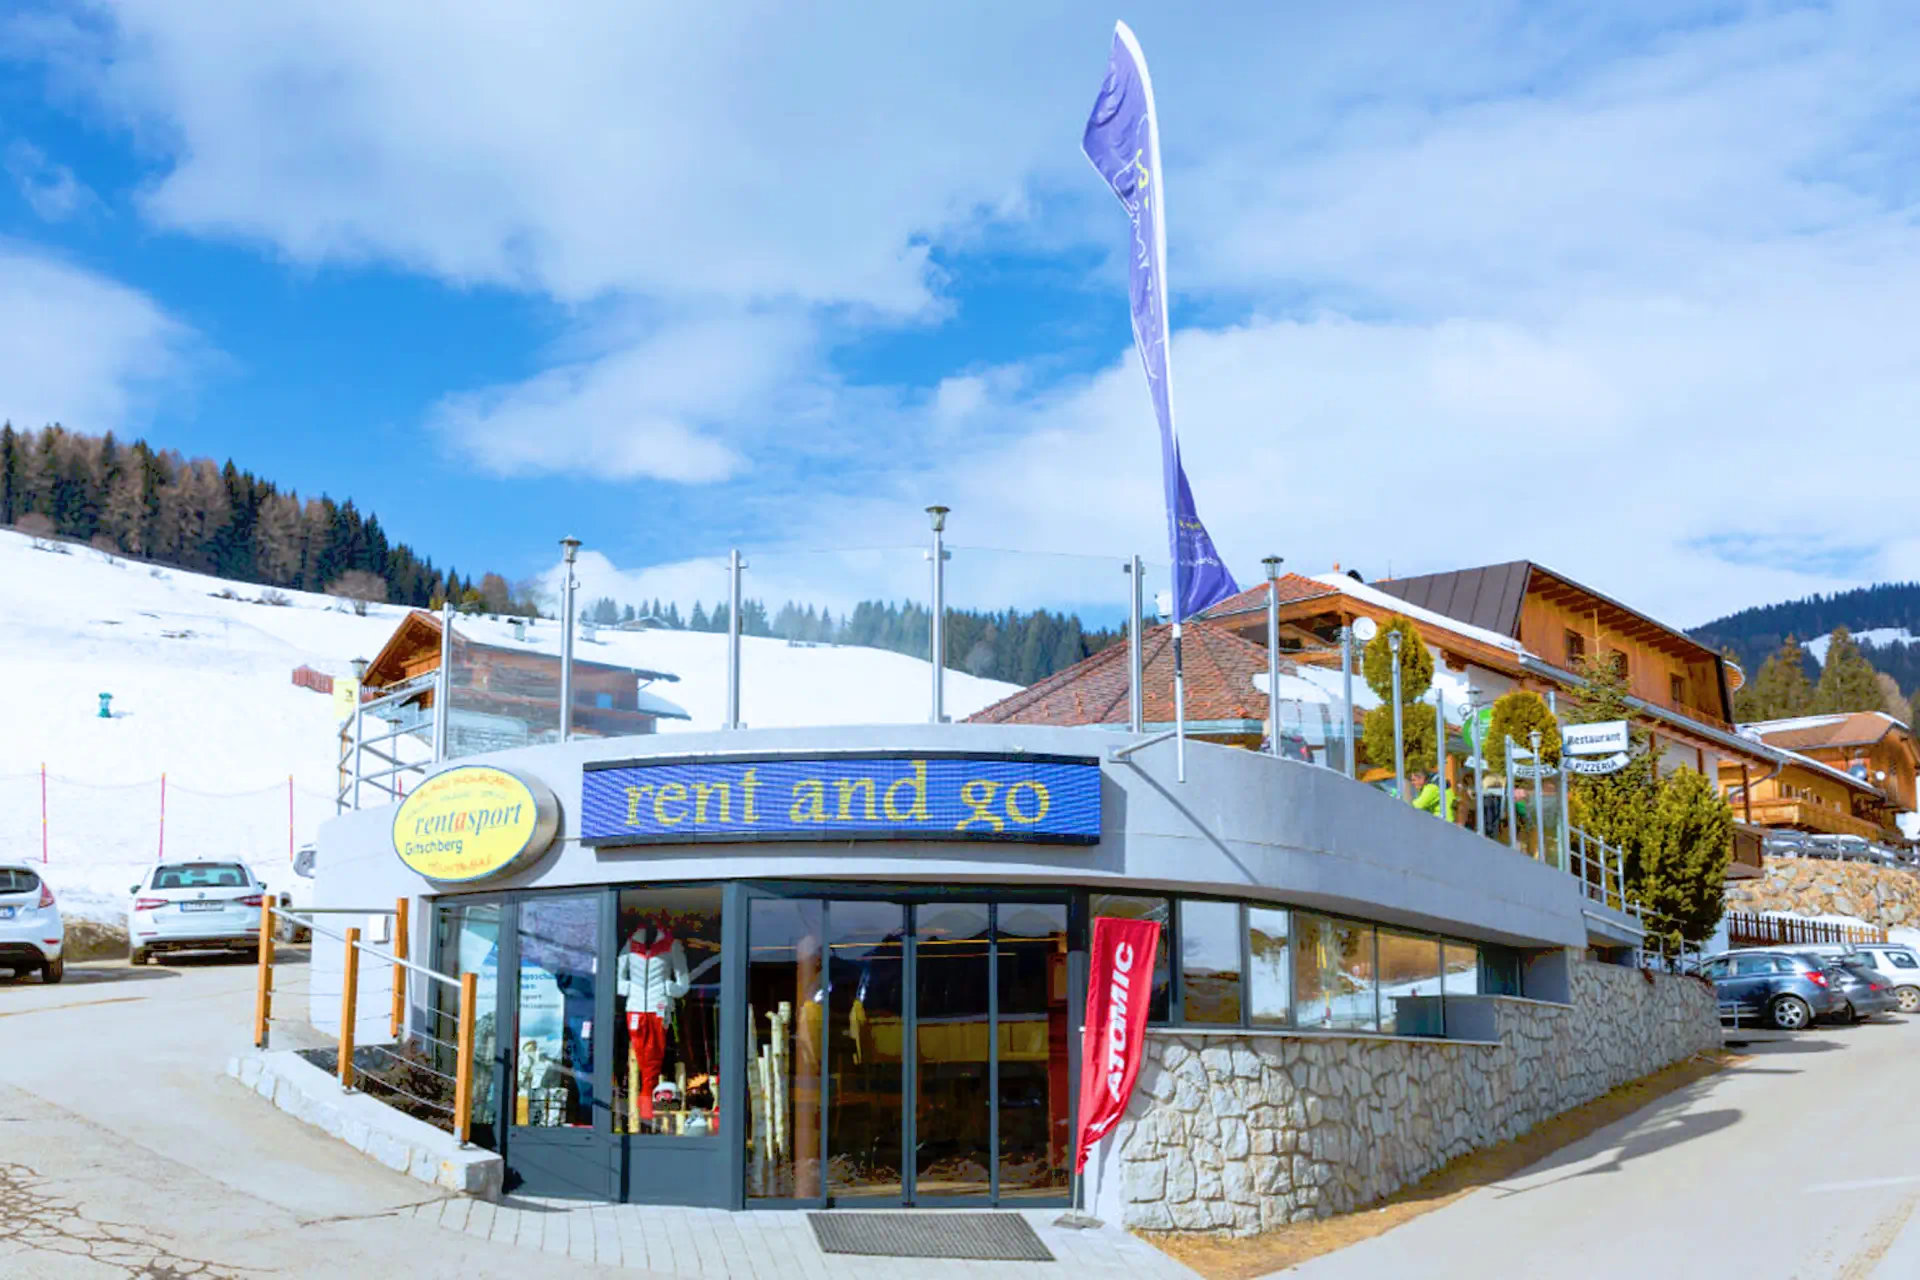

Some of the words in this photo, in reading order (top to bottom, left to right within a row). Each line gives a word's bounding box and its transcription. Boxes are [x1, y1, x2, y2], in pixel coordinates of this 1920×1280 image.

[1567, 733, 1621, 746] Restaurant
[1575, 759, 1617, 772] PIZZERIA
[624, 768, 761, 826] rent
[788, 759, 933, 822] and
[955, 779, 1050, 831] go
[405, 839, 463, 856] Gitschberg
[1107, 942, 1134, 1102] ATOMIC
